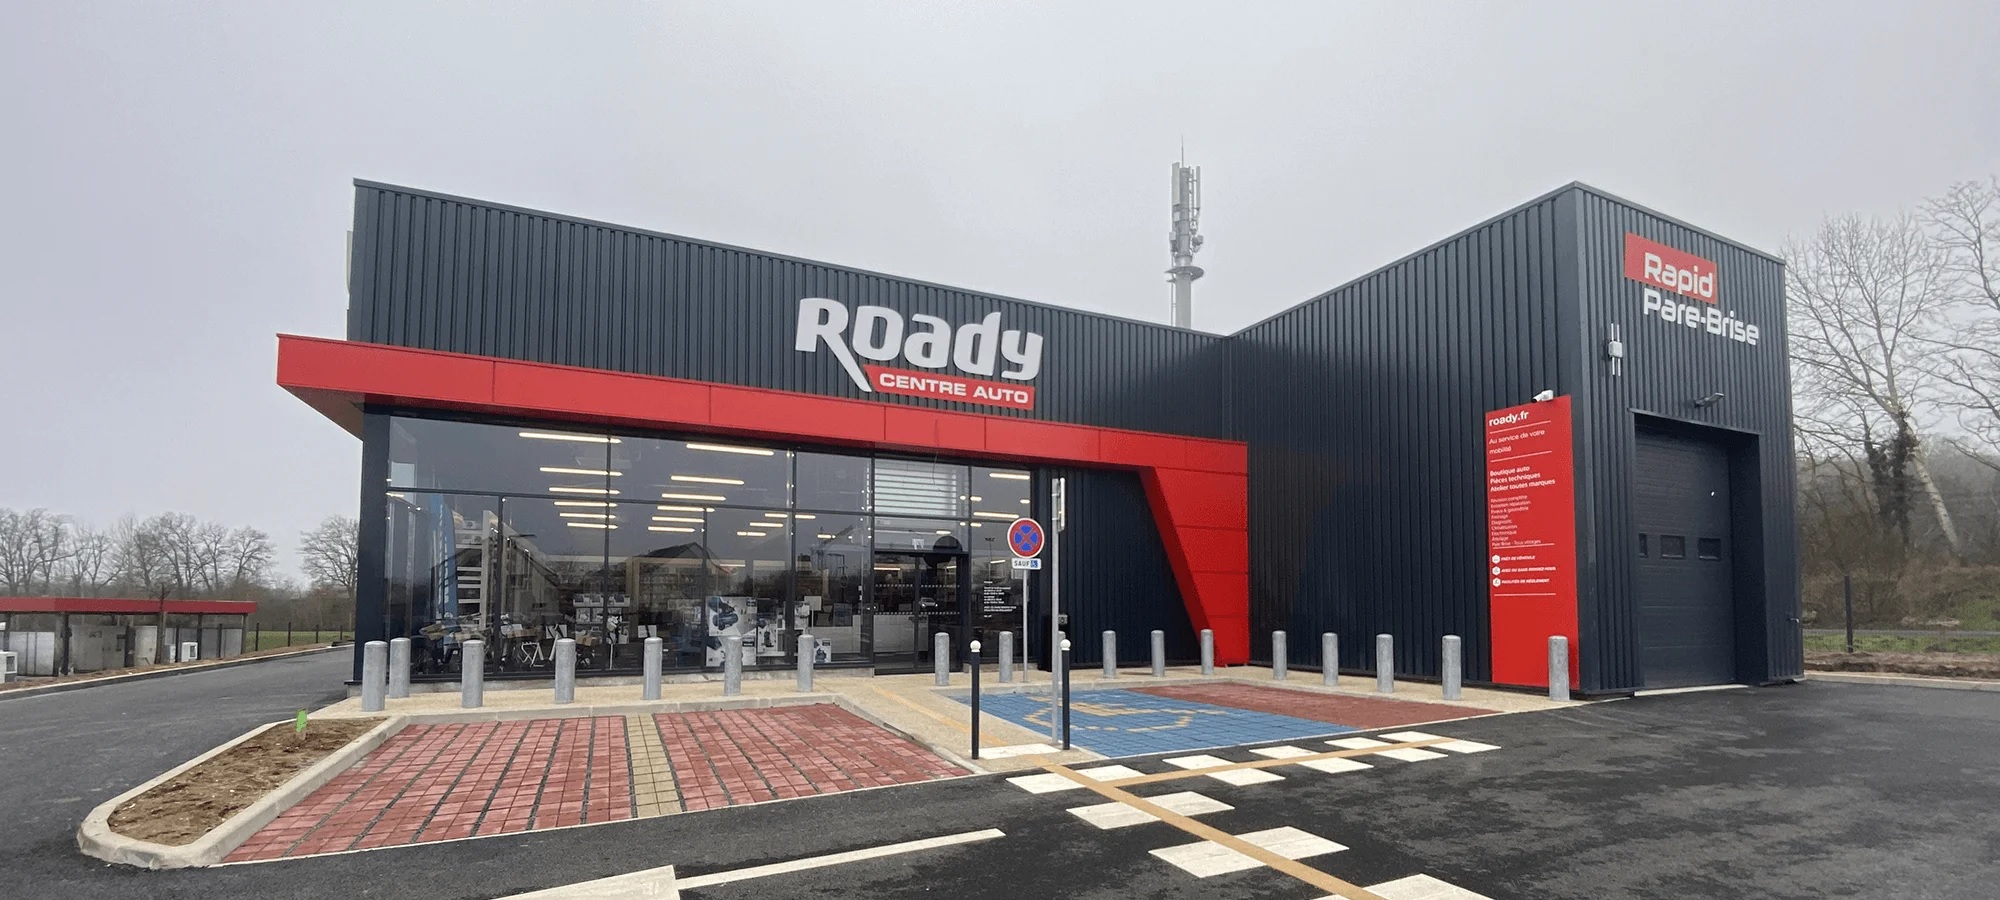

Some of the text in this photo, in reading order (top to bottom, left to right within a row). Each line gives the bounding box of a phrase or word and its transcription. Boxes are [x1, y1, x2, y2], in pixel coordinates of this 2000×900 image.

[1644, 252, 1713, 298] Rapid
[1643, 288, 1760, 346] Pare-Brise
[795, 297, 1044, 393] Roady
[879, 373, 1029, 405] CENTRE AUTO
[1488, 410, 1529, 427] roady.fr
[1498, 434, 1520, 443] service
[1520, 431, 1529, 439] de
[1529, 429, 1545, 437] votre
[1489, 446, 1512, 454] mobilité
[1490, 468, 1516, 477] Boutique
[1490, 472, 1541, 485] Pièces techniques
[1509, 482, 1528, 490] toutes
[1529, 479, 1556, 487] marques
